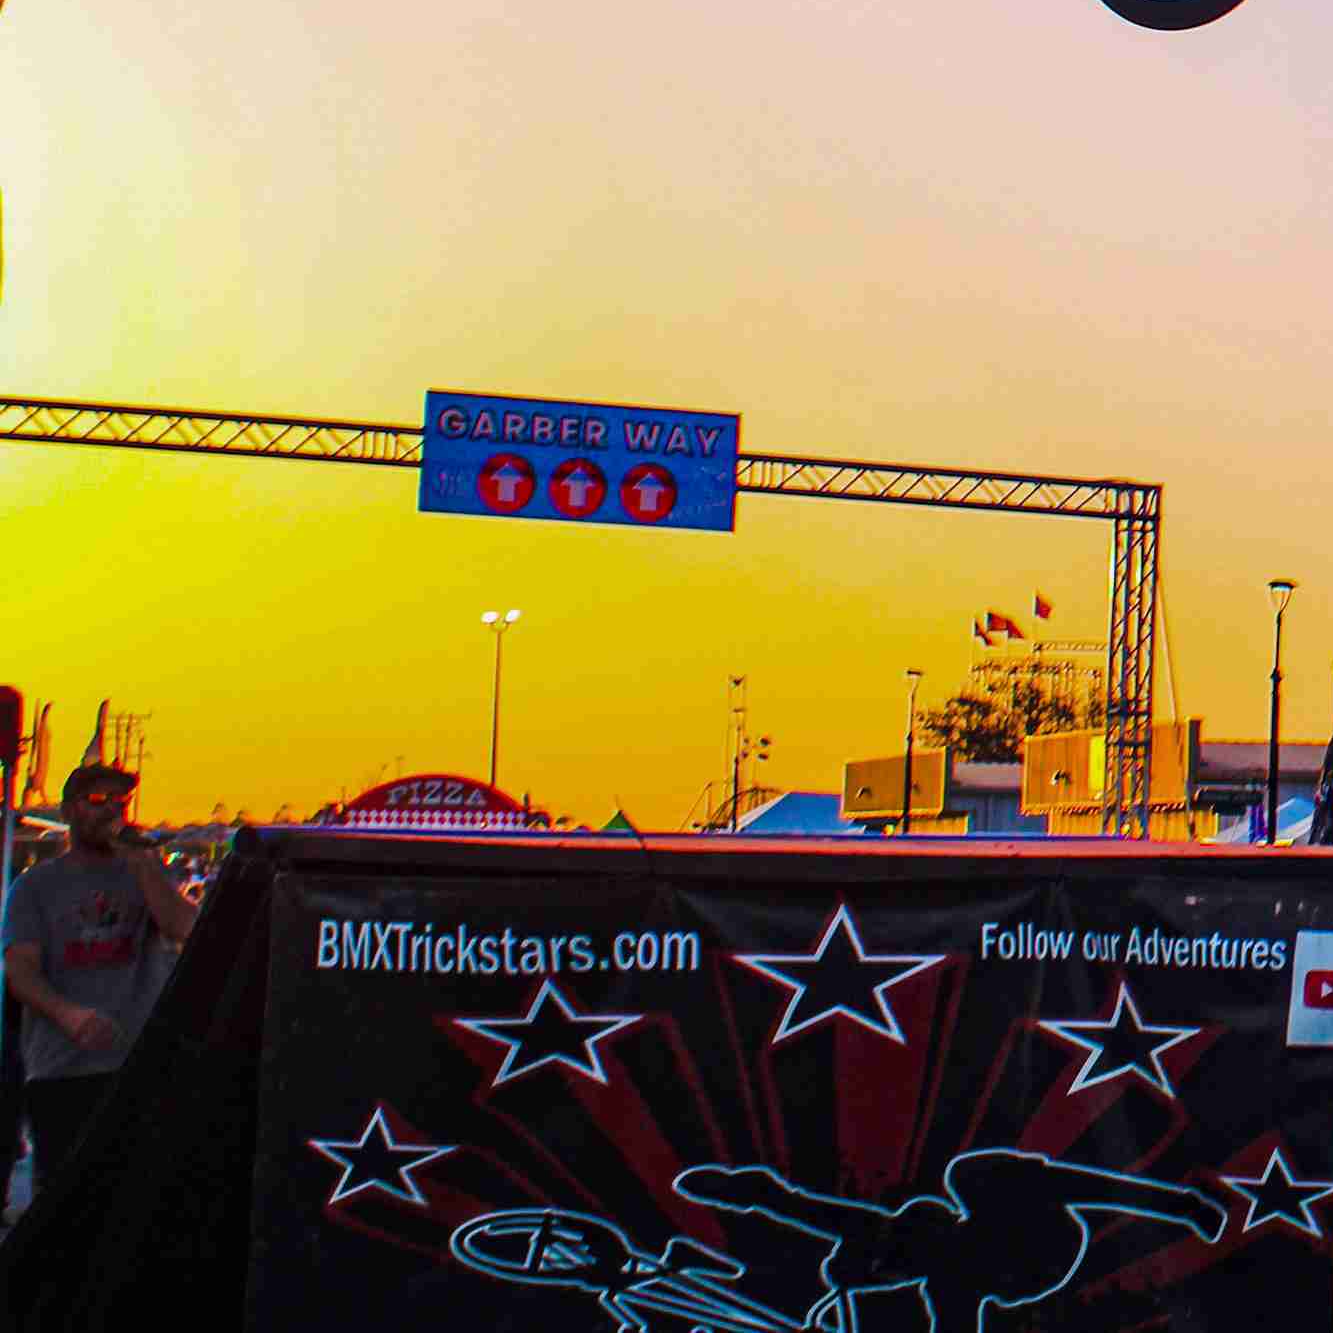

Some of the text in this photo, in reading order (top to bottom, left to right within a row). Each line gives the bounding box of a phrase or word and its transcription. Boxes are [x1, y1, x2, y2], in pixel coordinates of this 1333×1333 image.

[438, 408, 722, 455] GARBER WAY
[386, 779, 488, 808] PIZZA
[316, 918, 700, 975] BMXTrickstars.com
[980, 922, 1288, 970] Follow our Adventures
